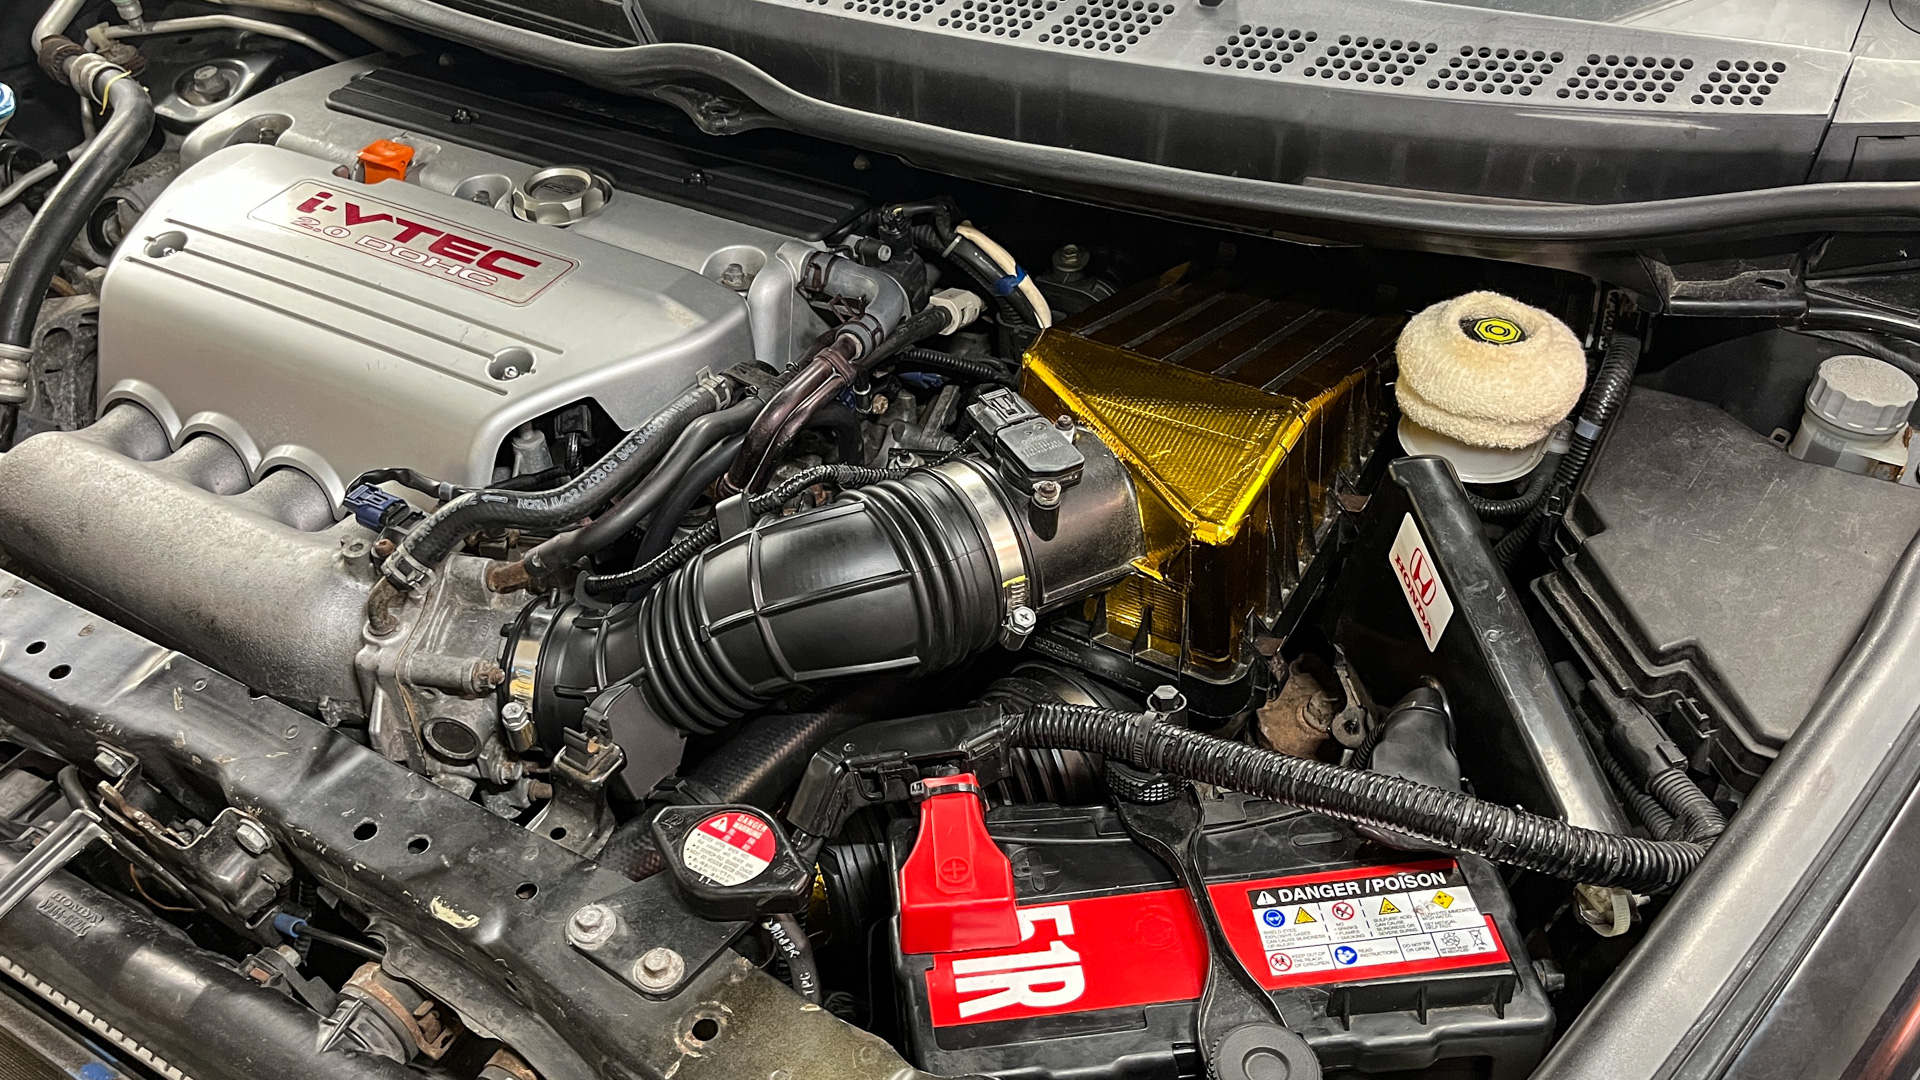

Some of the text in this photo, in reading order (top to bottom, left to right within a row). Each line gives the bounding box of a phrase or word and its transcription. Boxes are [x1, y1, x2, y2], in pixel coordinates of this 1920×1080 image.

[290, 216, 498, 287] 2.0 DOHC
[296, 191, 542, 281] i-VTEC
[1394, 553, 1432, 641] HONDA
[737, 815, 768, 832] DANGER
[51, 891, 100, 925] HONDA
[1278, 882, 1361, 902] DANGER
